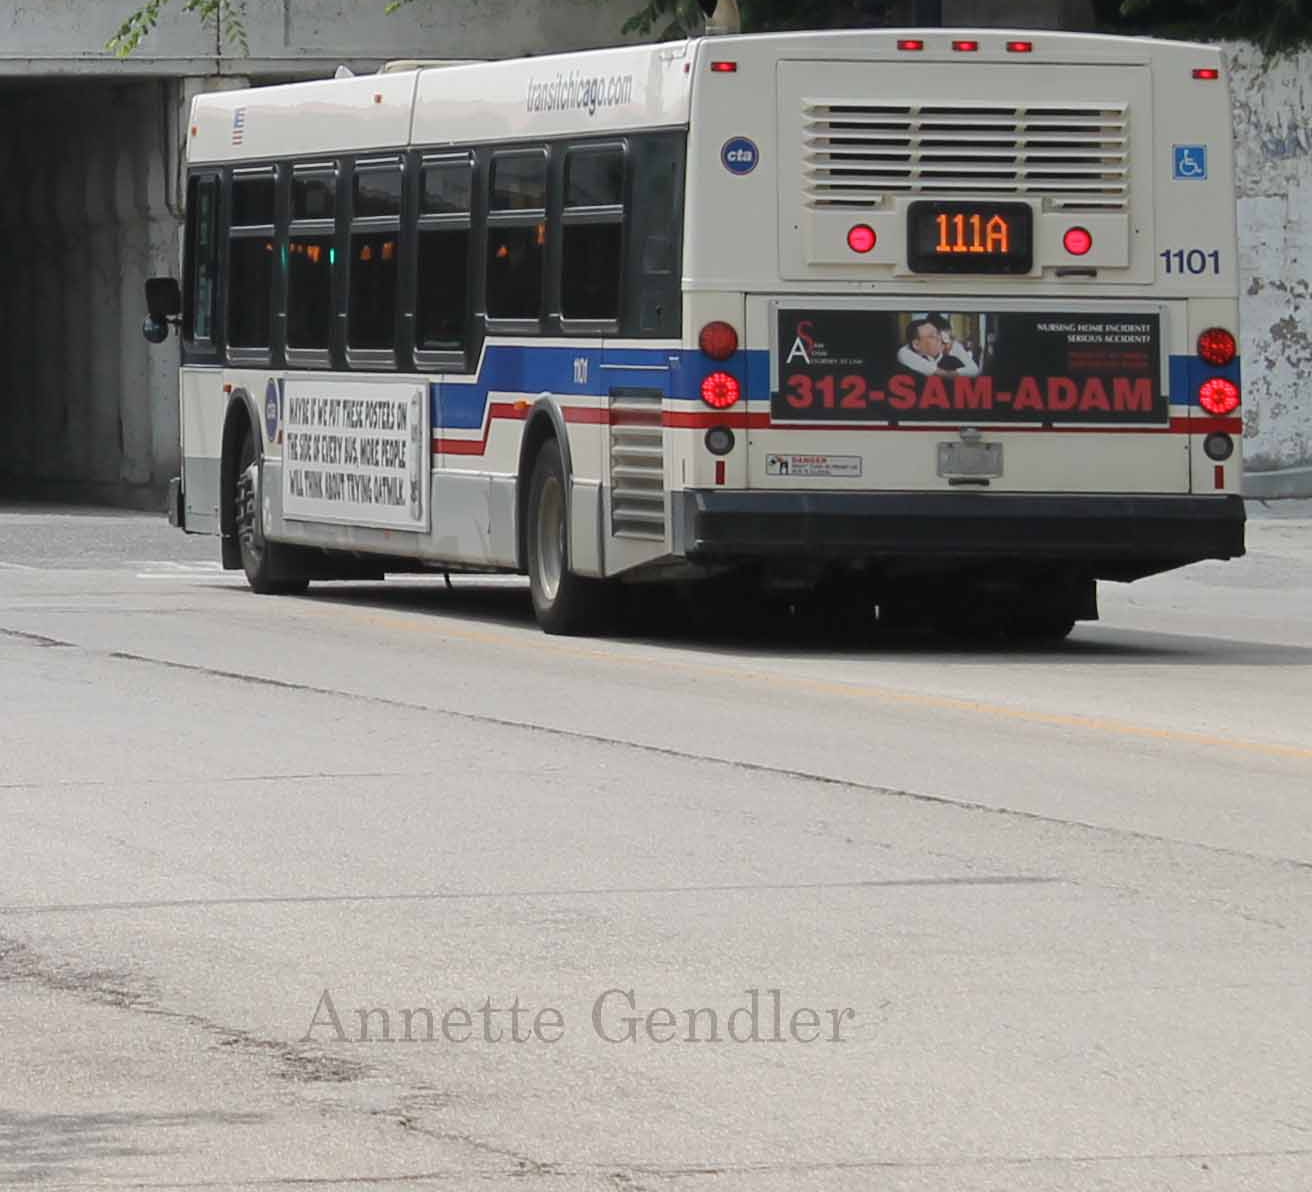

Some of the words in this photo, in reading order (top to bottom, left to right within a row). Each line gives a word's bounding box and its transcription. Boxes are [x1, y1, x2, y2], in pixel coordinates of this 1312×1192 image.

[527, 70, 632, 116] transitchicago.com
[727, 148, 753, 162] cta
[936, 214, 1008, 252] 111A
[1160, 248, 1219, 274] 1101
[786, 374, 1152, 412] 312-SAM-ADAM
